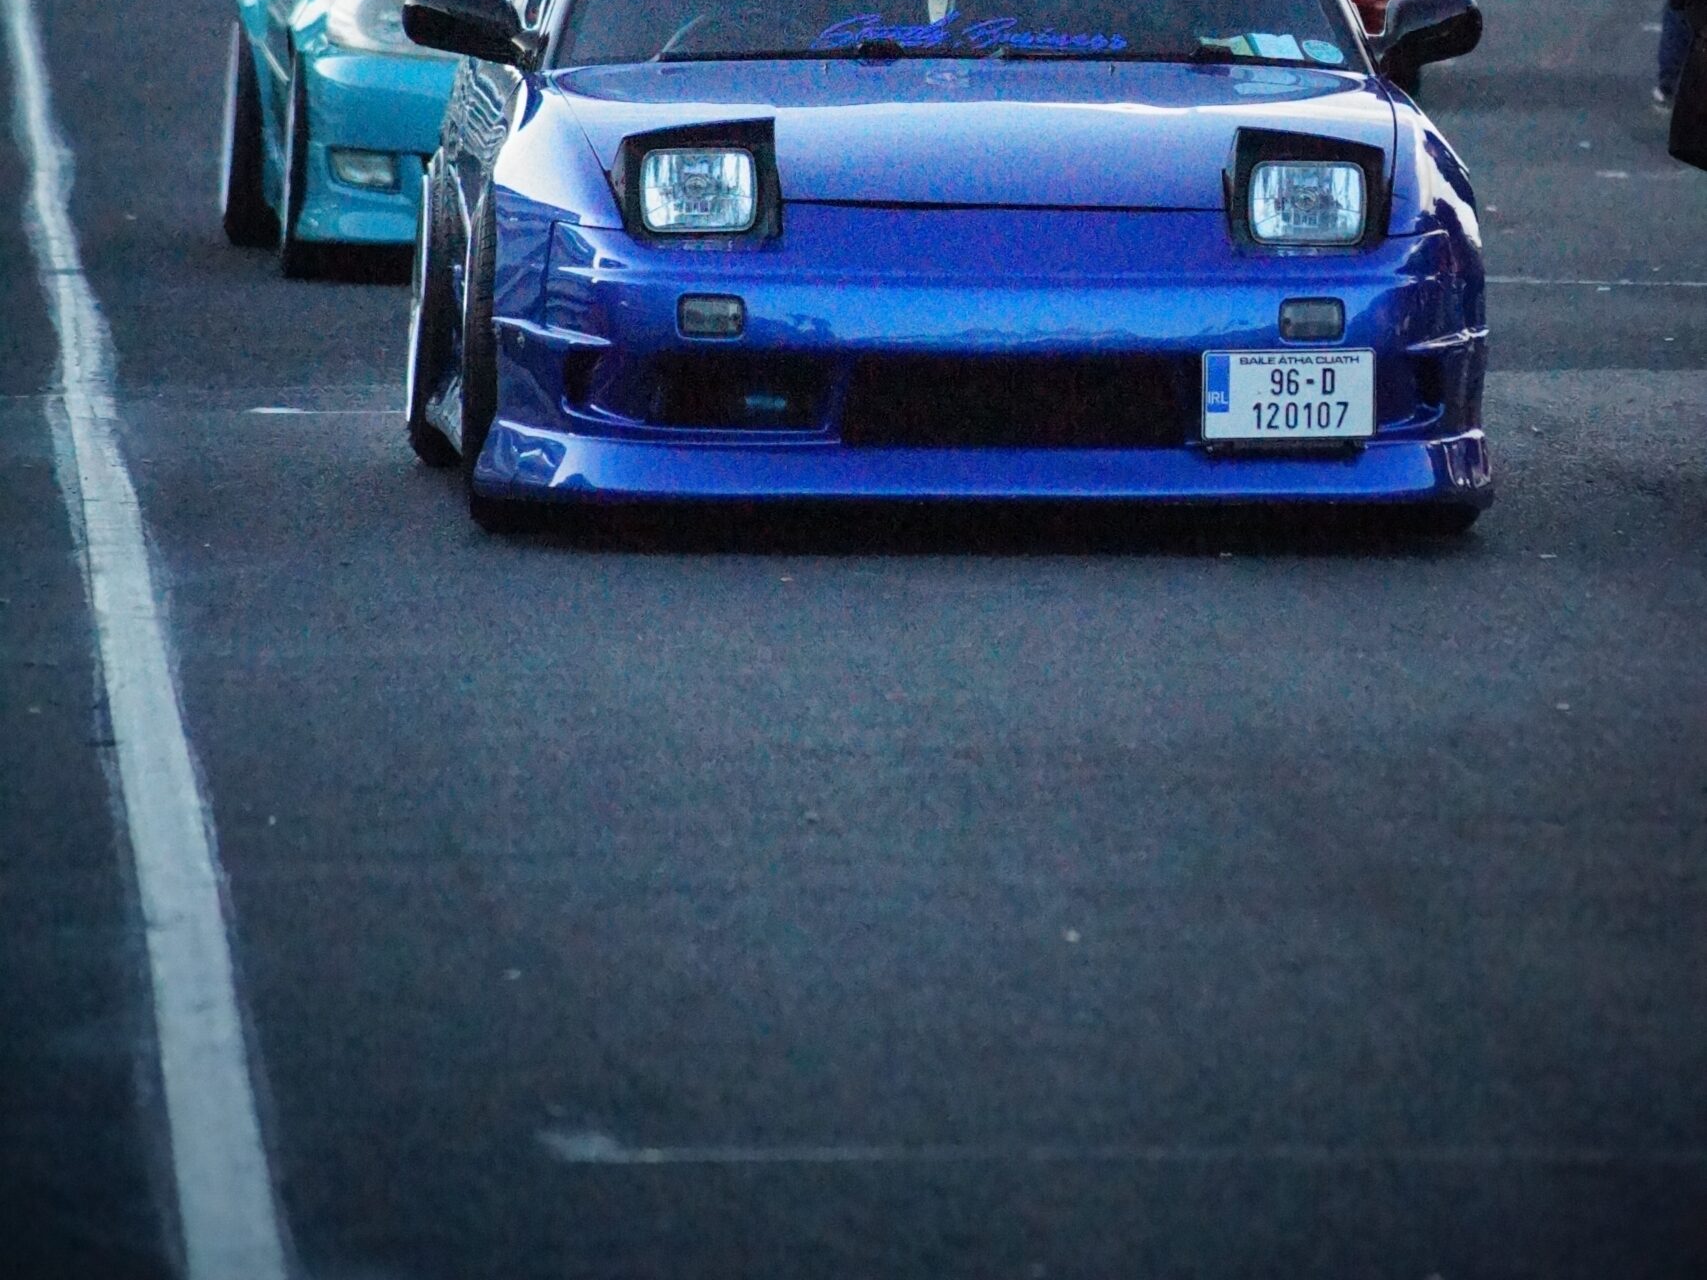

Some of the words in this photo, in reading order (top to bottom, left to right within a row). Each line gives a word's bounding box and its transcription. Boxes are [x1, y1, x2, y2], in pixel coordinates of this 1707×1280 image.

[1239, 355, 1276, 366] BAILE
[1270, 368, 1335, 396] 96-D
[1207, 391, 1228, 404] IRL
[1252, 401, 1349, 430] 120107
